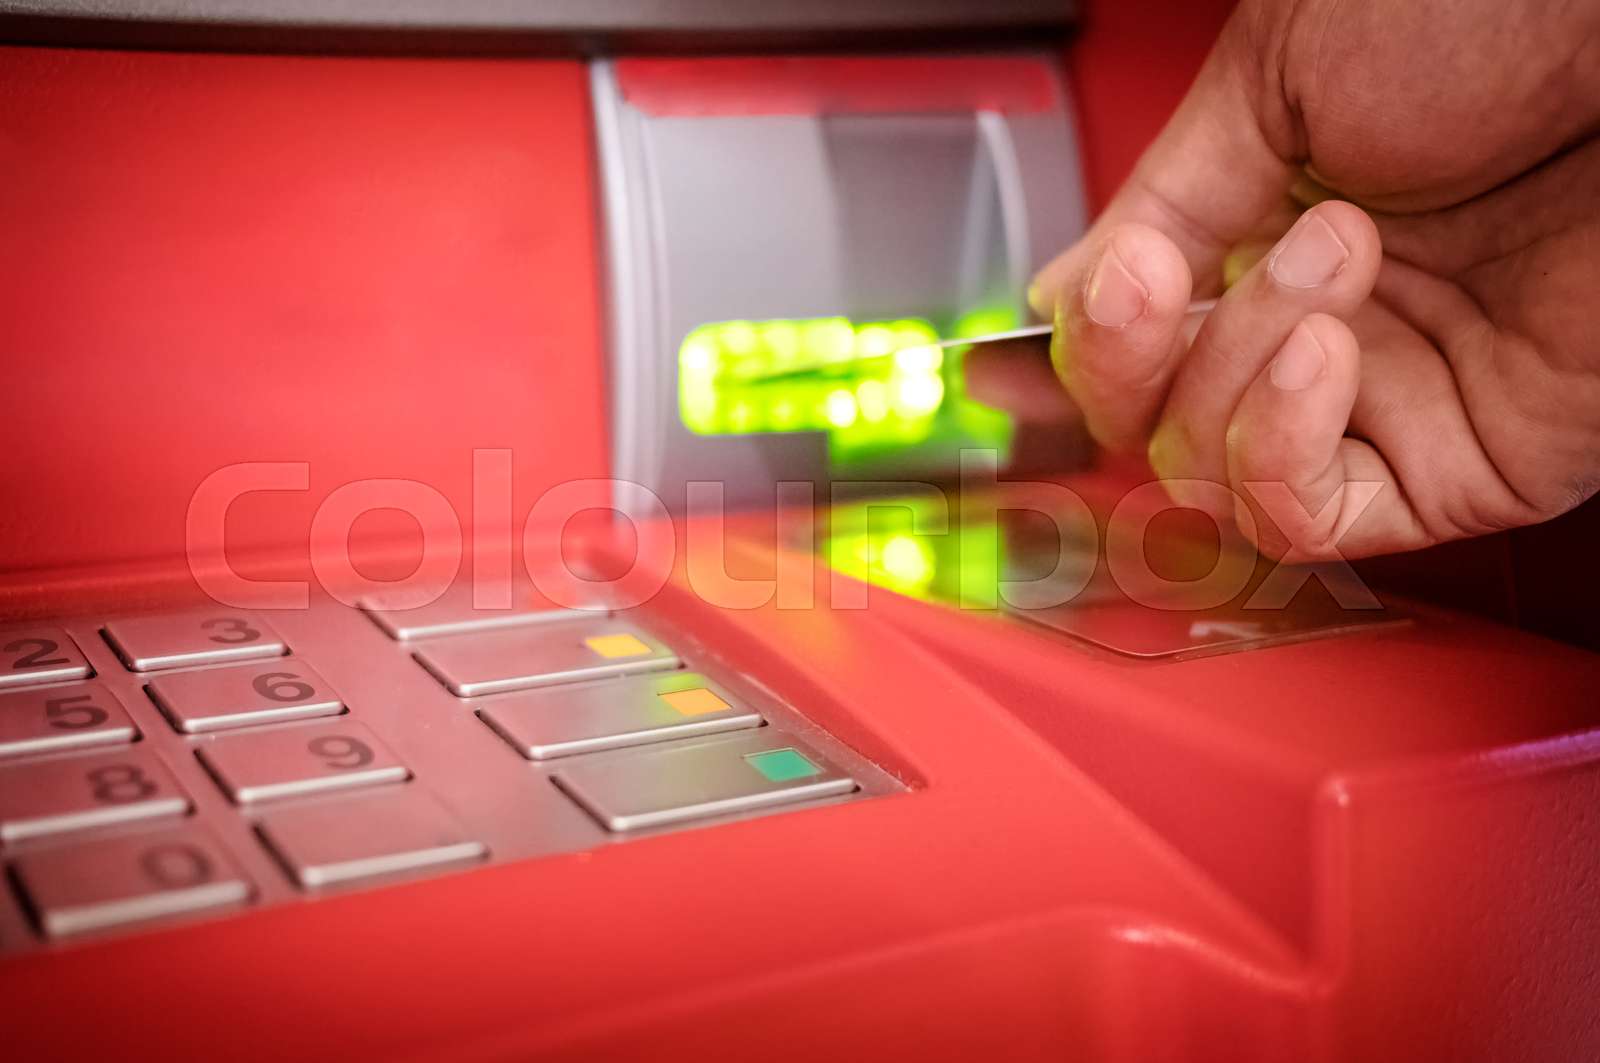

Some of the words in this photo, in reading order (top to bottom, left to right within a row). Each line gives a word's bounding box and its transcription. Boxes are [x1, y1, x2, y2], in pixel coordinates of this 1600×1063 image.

[200, 617, 262, 644] 3
[3, 638, 71, 669] 2
[252, 672, 315, 702] 6
[45, 695, 109, 729] 5
[307, 735, 375, 770] 9
[86, 765, 158, 801] 8
[139, 844, 211, 889] 0
